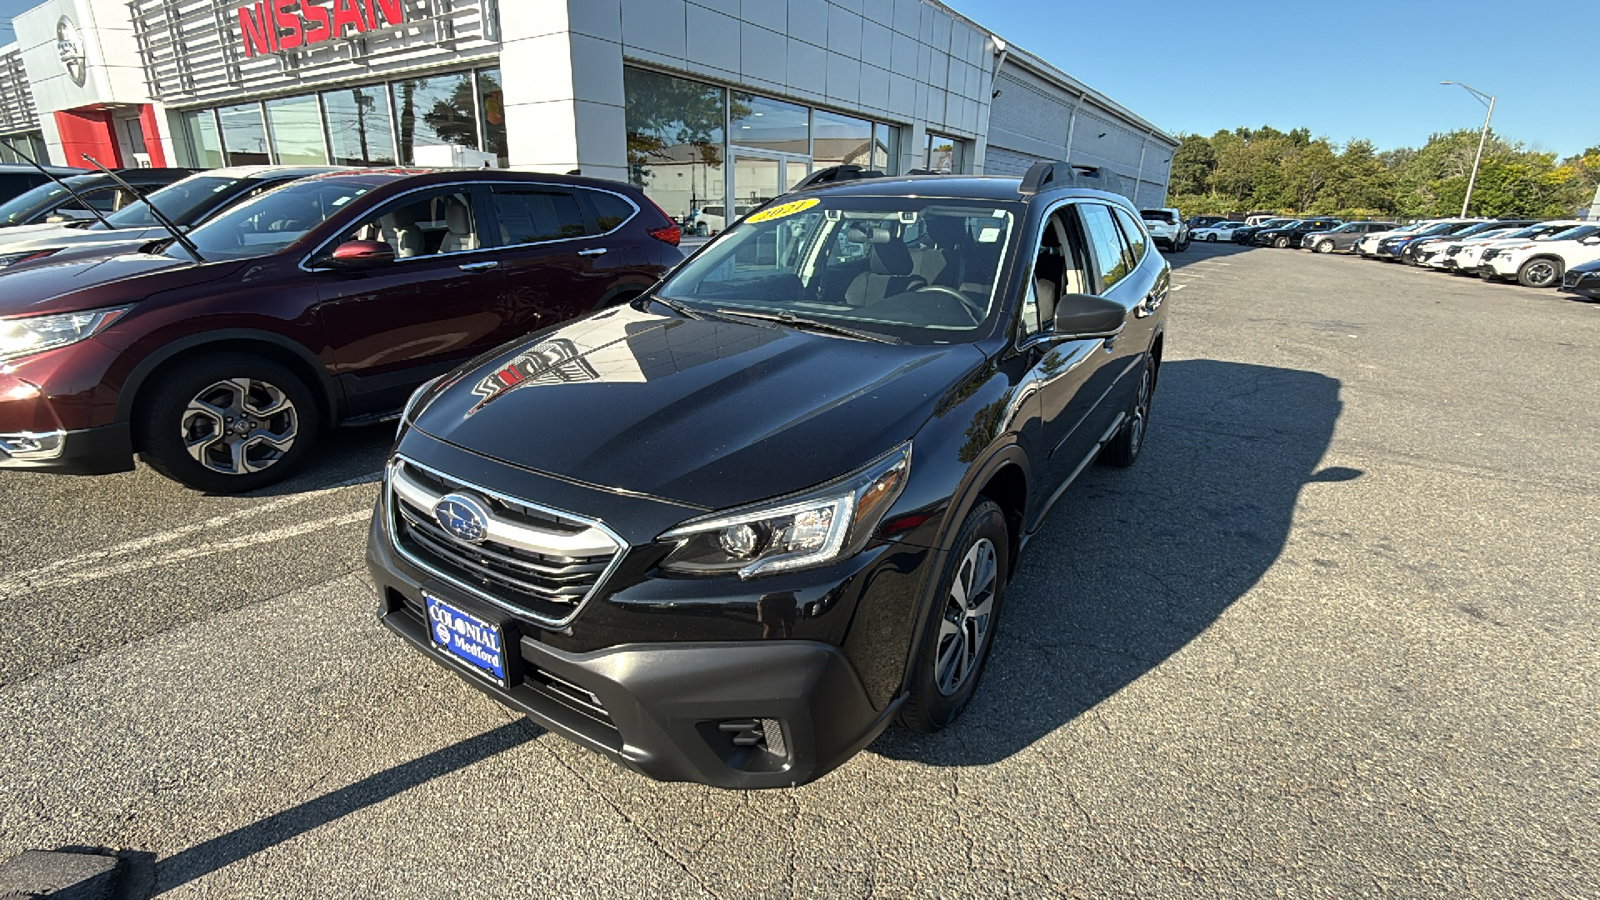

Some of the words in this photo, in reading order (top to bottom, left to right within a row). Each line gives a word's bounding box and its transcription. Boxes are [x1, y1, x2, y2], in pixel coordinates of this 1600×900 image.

[238, 0, 403, 58] NISSAN
[429, 604, 500, 652] COLONIAL
[454, 634, 500, 668] Medford
